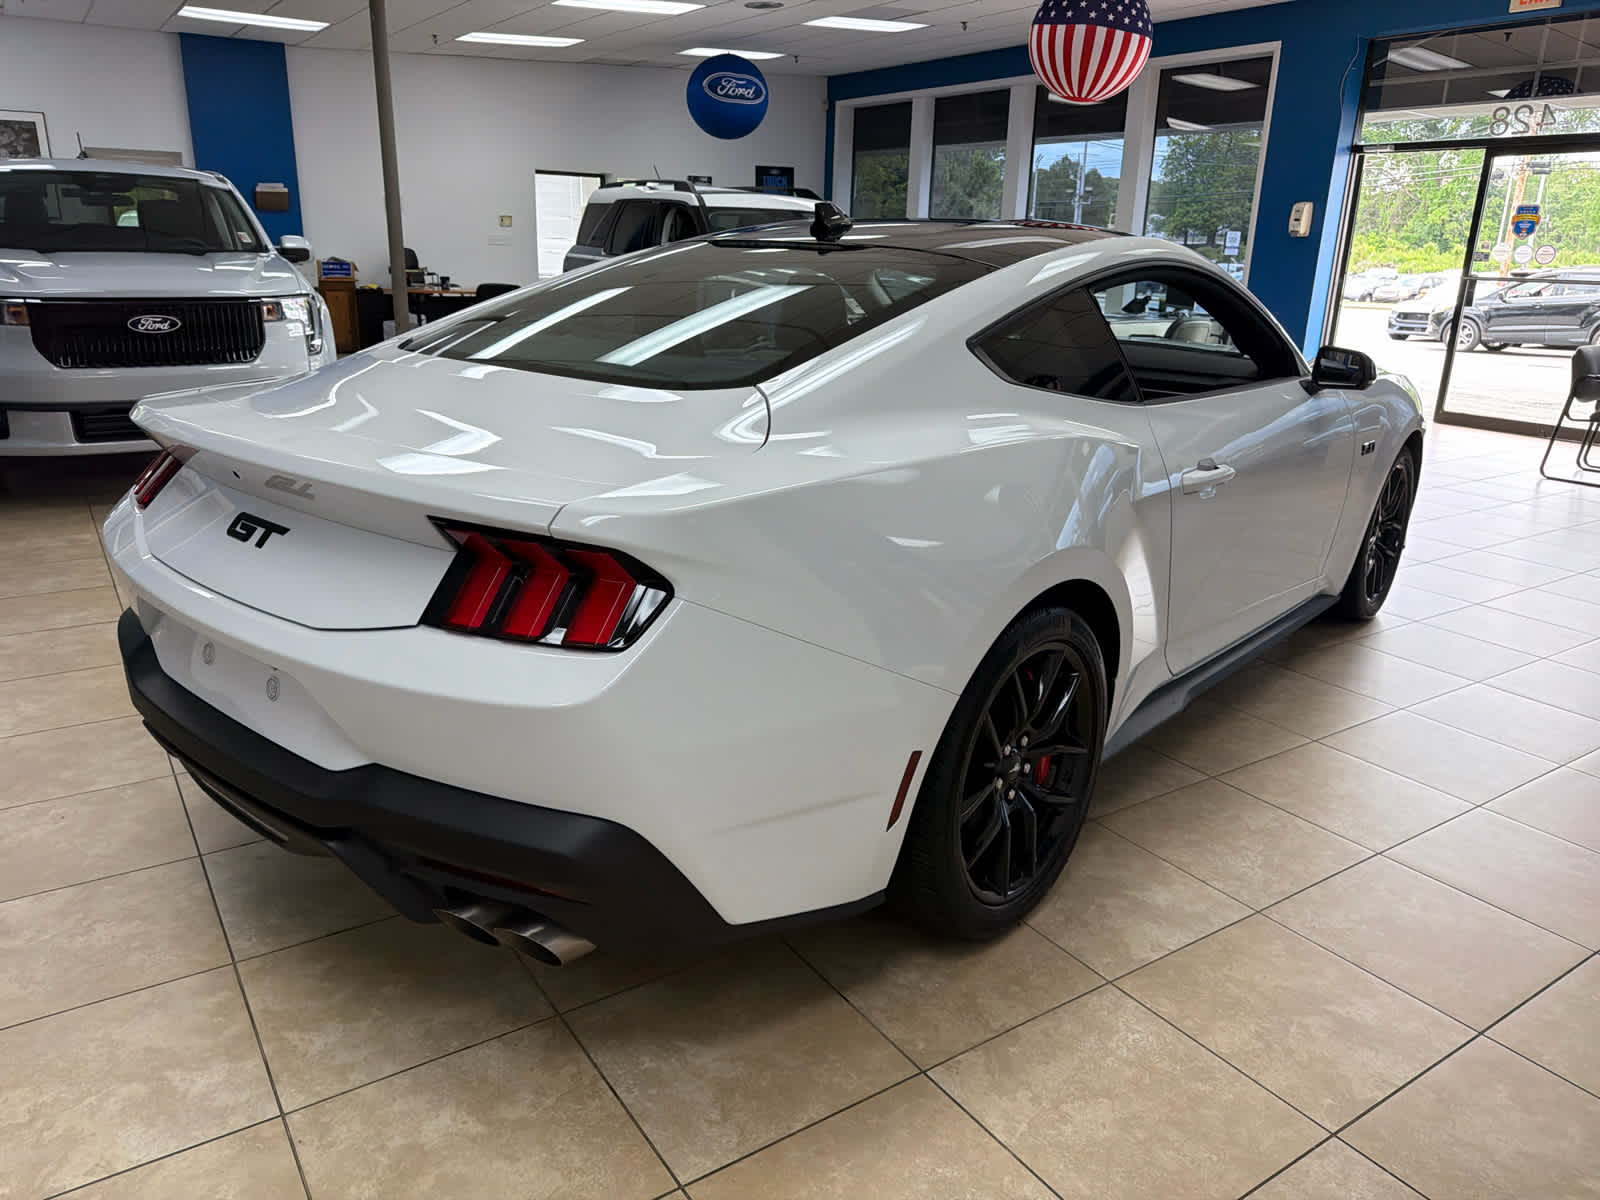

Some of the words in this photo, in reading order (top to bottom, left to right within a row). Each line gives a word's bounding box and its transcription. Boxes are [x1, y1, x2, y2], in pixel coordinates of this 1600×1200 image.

[717, 77, 756, 99] Ford
[138, 317, 171, 330] Ford
[226, 511, 291, 549] GT
